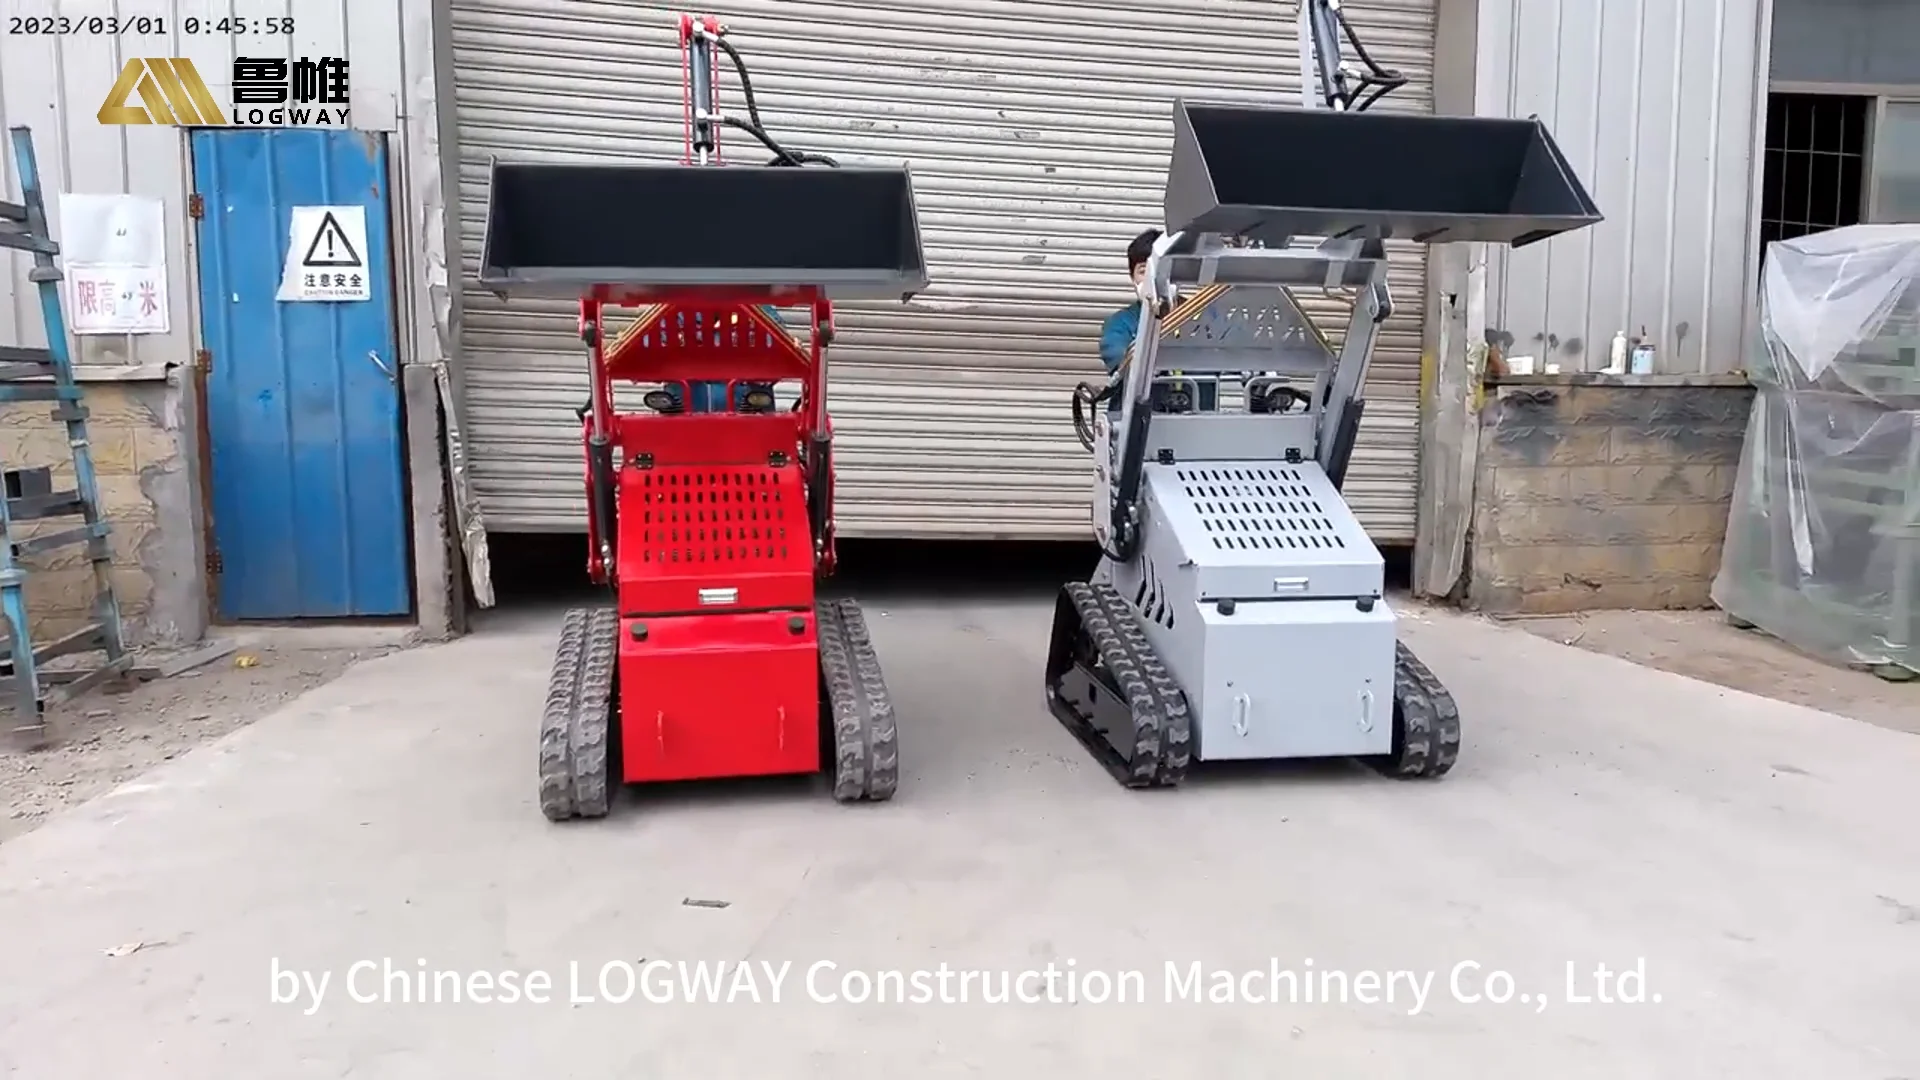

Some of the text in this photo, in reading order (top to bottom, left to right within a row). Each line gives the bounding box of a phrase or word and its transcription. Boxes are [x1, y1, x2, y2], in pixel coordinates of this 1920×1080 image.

[304, 273, 362, 287] 注意安全
[77, 279, 158, 317] 限高 米
